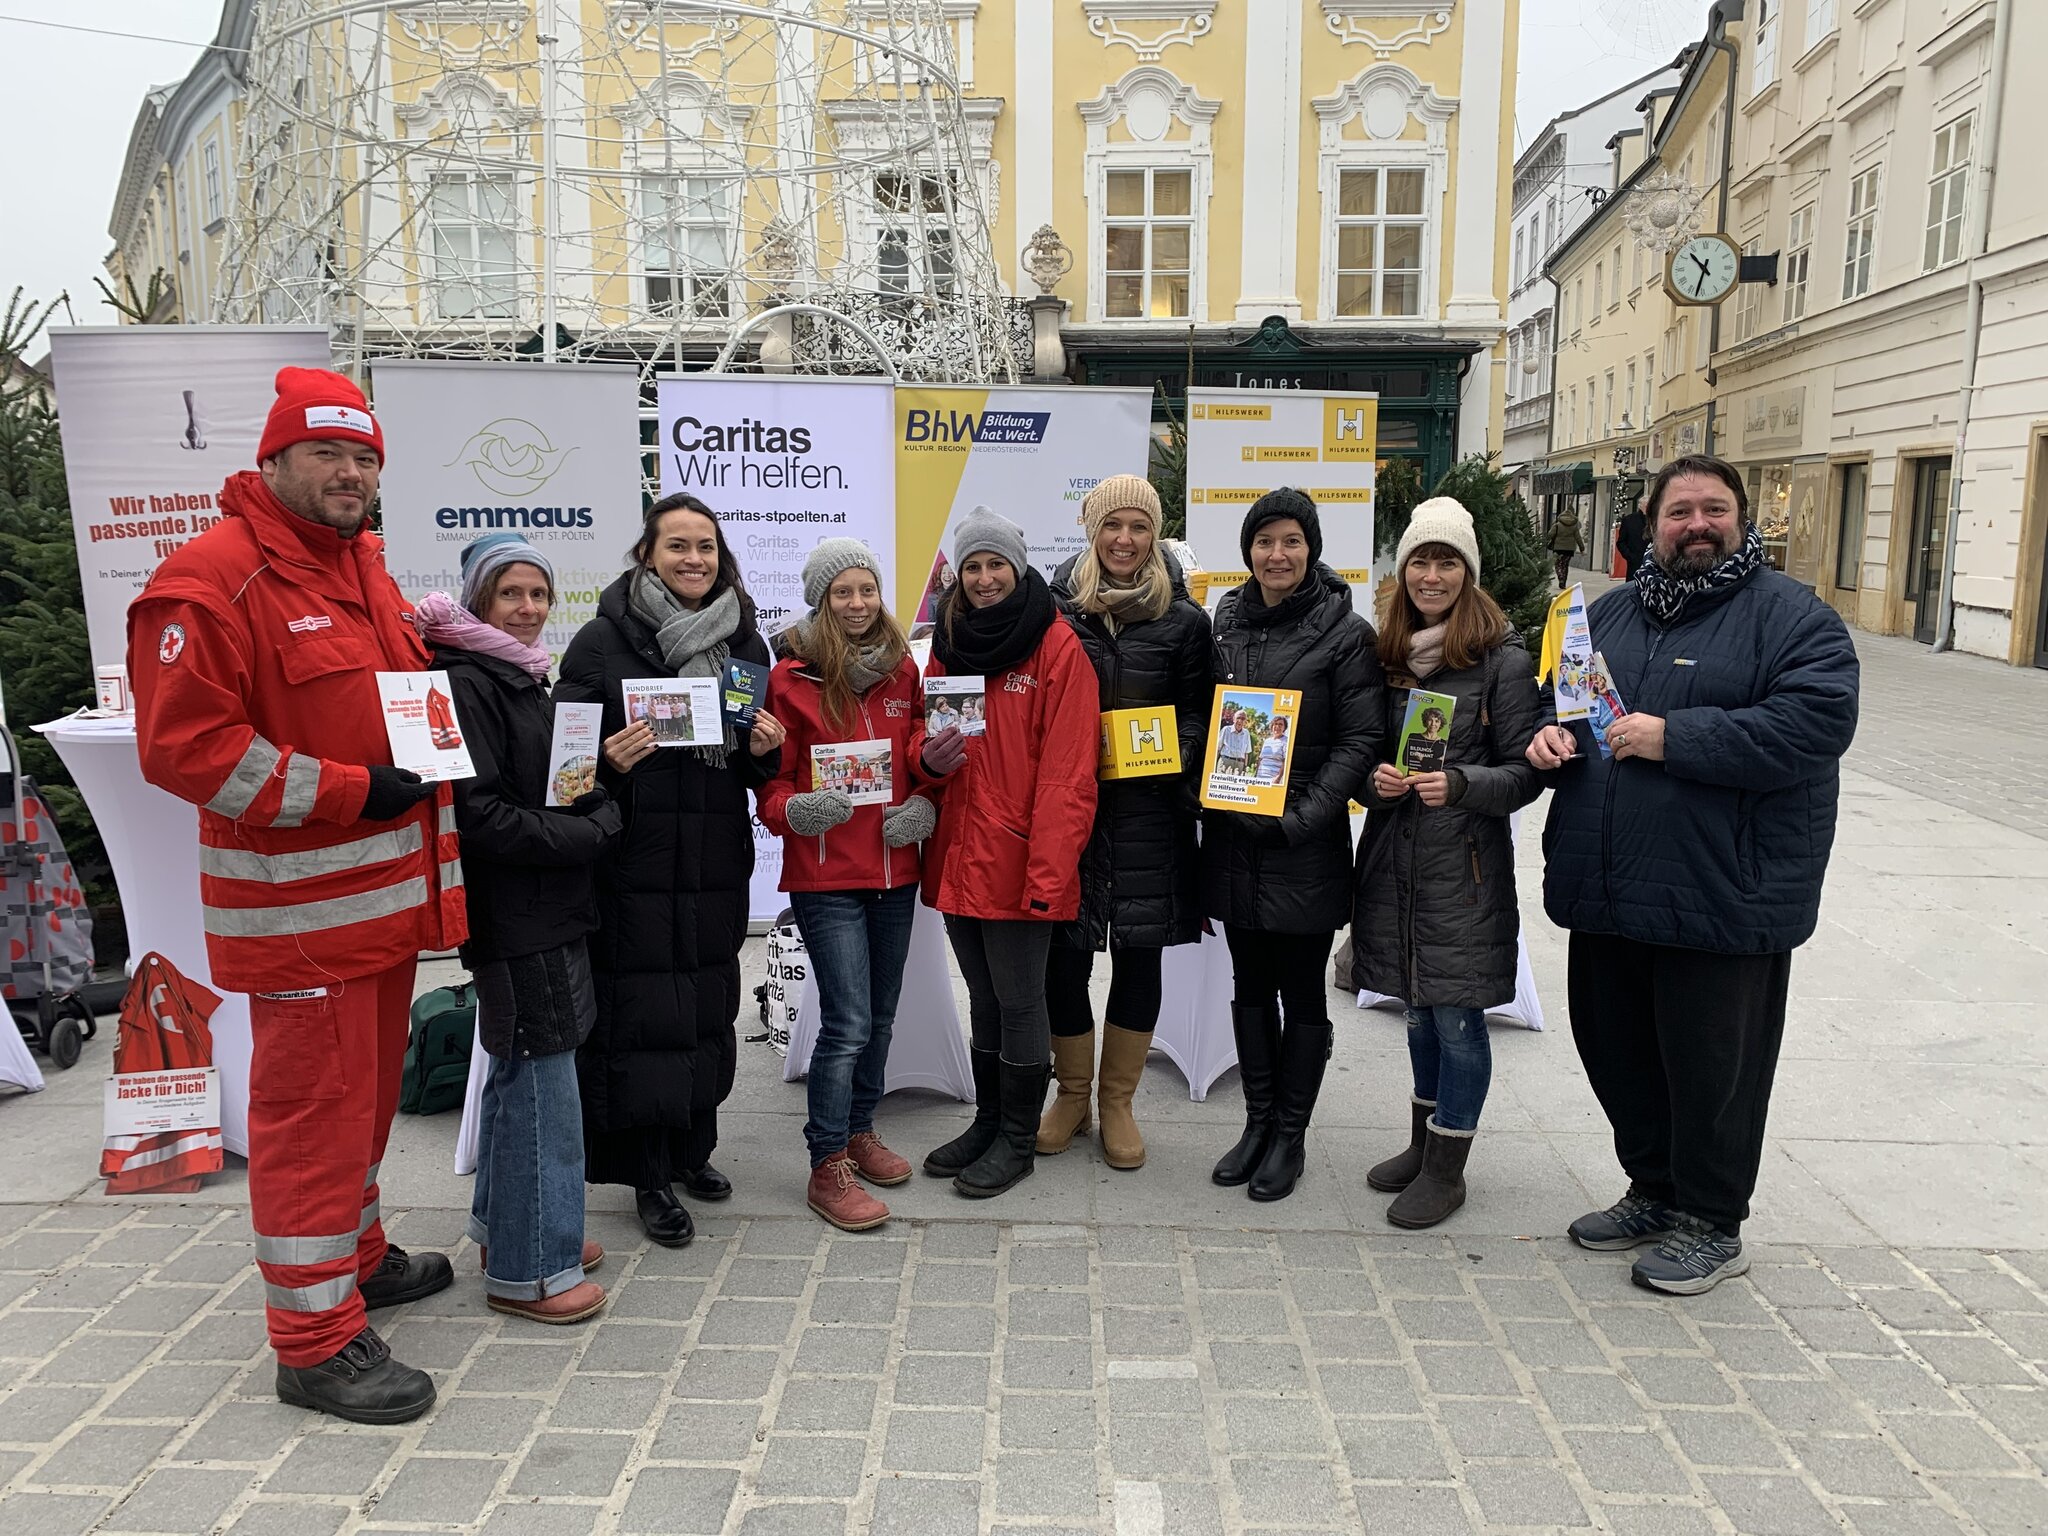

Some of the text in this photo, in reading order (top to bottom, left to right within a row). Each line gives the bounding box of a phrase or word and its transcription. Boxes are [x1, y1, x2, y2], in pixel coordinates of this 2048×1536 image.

[1215, 408, 1264, 416] HILFSWERK
[905, 409, 979, 442] BhW
[985, 415, 1034, 429] Bildung
[672, 416, 812, 453] Caritas
[980, 429, 1039, 442] hat Wert.
[972, 446, 1038, 454] NIEDERÖSTERREICH
[1264, 450, 1311, 458] HILFSWERK
[675, 454, 849, 489] Wir helfen.
[1063, 490, 1088, 501] MOT
[109, 496, 146, 516] Wir
[149, 493, 212, 513] haben
[436, 507, 593, 529] emmaus
[89, 516, 187, 542] passende
[548, 531, 560, 540] ST.
[562, 530, 594, 540] PÖLTEN
[746, 534, 799, 548] Caritas
[747, 549, 769, 561] Wir
[99, 570, 108, 578] In
[111, 569, 141, 578] Deiner
[558, 568, 609, 585] ktive
[747, 570, 800, 583] Caritas
[564, 586, 602, 604] woh
[748, 585, 803, 597] Wir helfe
[1007, 672, 1038, 688] Caritas
[1003, 682, 1026, 694] &Du
[883, 697, 911, 709] Caritas
[885, 707, 903, 718] &Du
[1125, 758, 1173, 767] HILFSWERK
[1211, 774, 1270, 787] Freiwillig engagieren
[1218, 784, 1246, 793] Hilfswerk
[1208, 792, 1256, 803] Niederösterreich
[118, 1078, 131, 1086] Wir
[157, 1075, 168, 1083] die
[170, 1073, 205, 1082] passende
[117, 1081, 206, 1099] Jacke für Dich!
